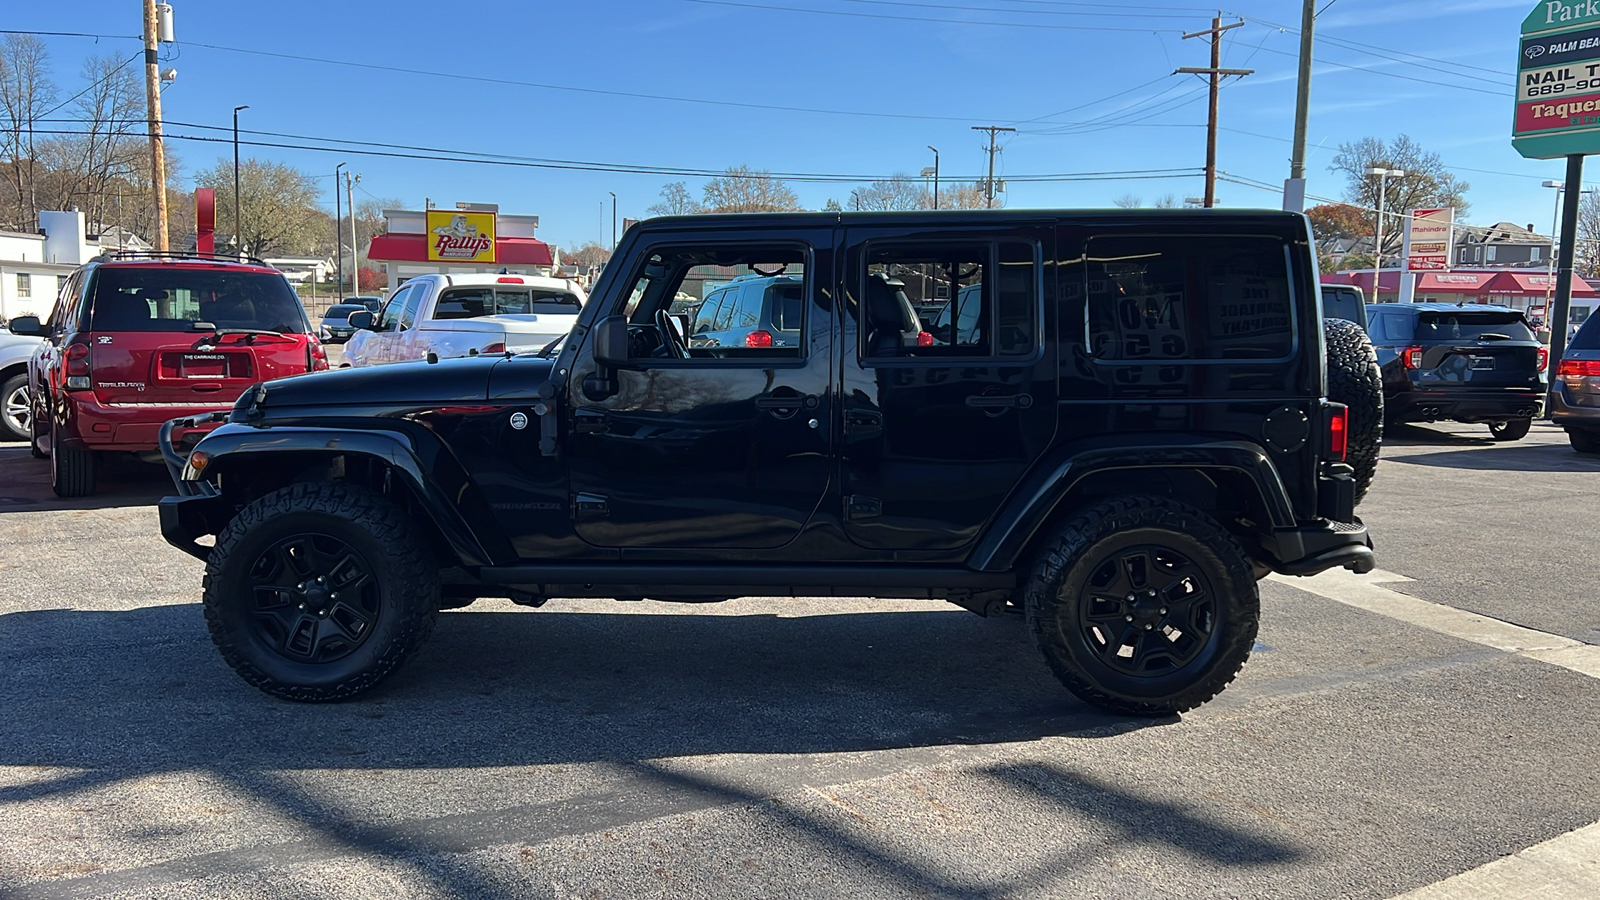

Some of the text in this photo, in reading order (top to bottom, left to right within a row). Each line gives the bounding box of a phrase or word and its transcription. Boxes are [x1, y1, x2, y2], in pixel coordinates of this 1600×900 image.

[1545, 0, 1600, 24] Park
[1549, 37, 1600, 54] PALM BEA
[1526, 68, 1575, 86] NAIL
[434, 233, 491, 258] Rally's
